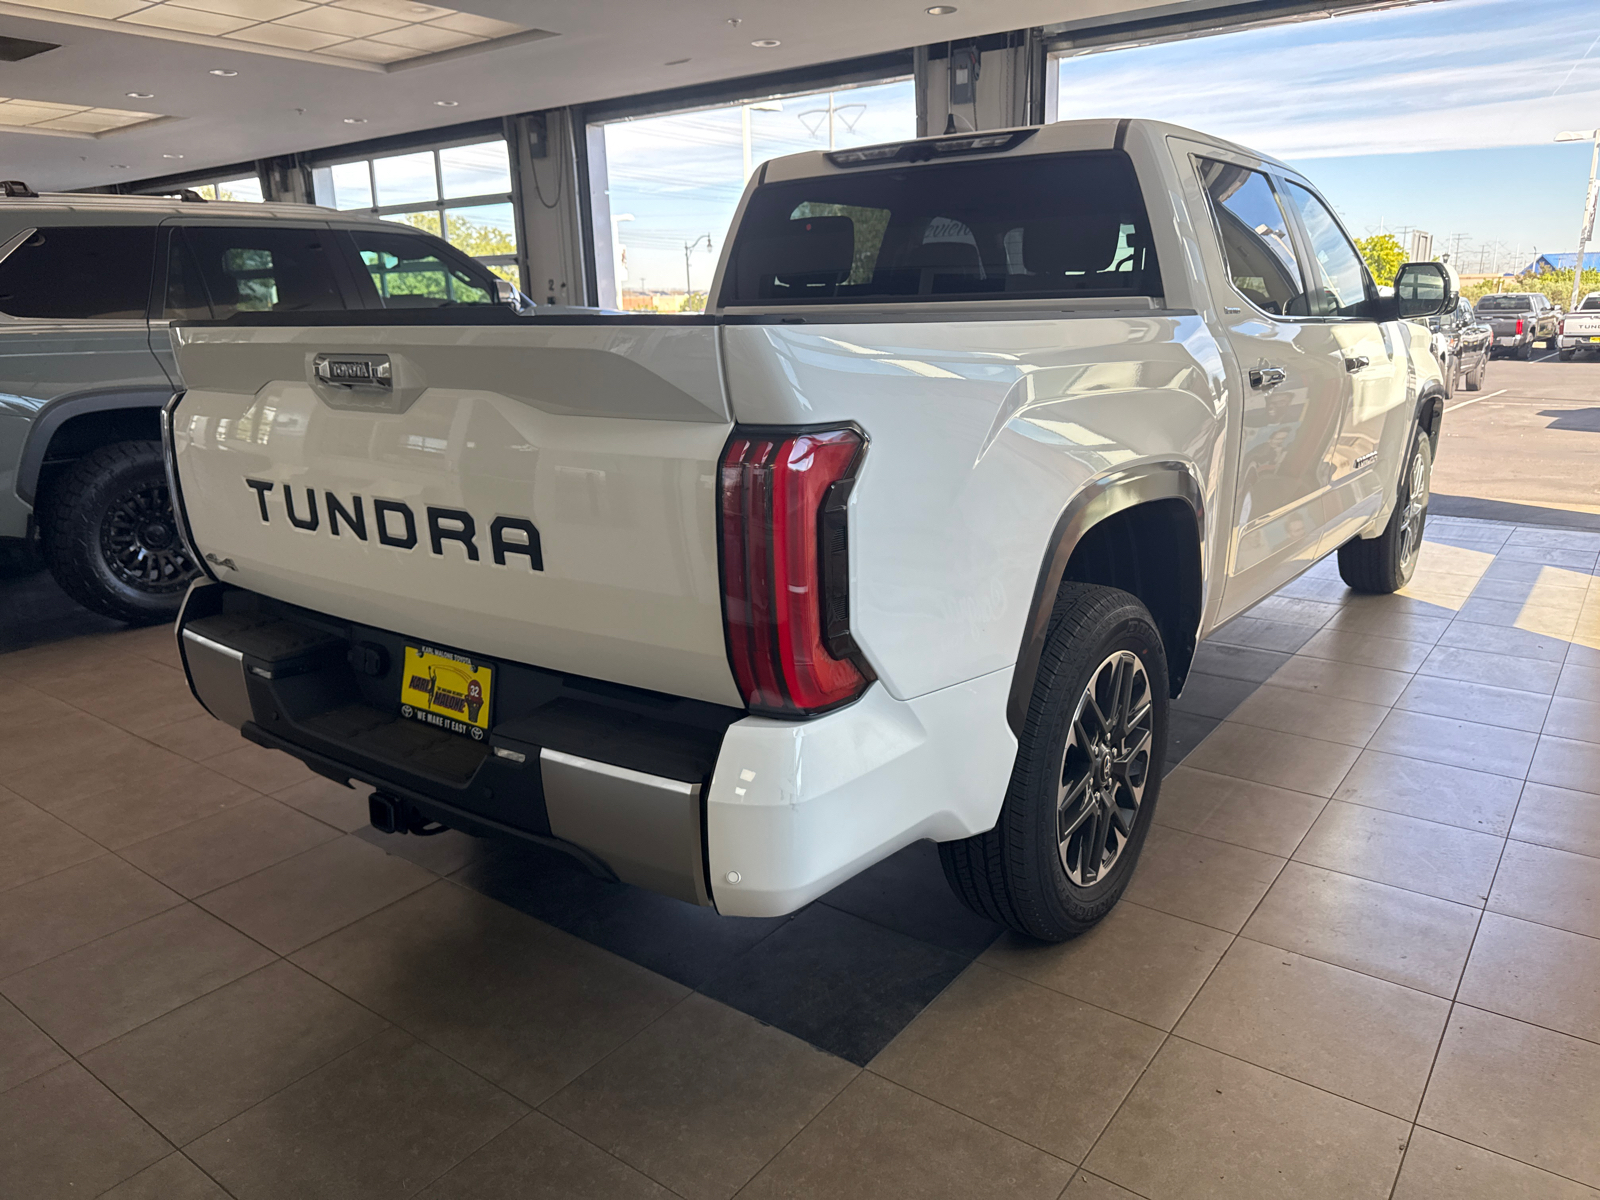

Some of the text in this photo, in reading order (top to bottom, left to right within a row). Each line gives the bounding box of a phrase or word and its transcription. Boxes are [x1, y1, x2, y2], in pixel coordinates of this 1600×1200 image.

[548, 279, 555, 291] 2
[332, 363, 368, 377] TOYOTA
[245, 478, 544, 572] TUNDRA
[421, 646, 434, 655] KARL
[453, 655, 471, 664] TOYOTA
[409, 674, 432, 694] KARL
[470, 685, 479, 697] 32
[433, 691, 466, 713] MALONE
[427, 714, 443, 727] MAKE
[444, 719, 450, 729] IT
